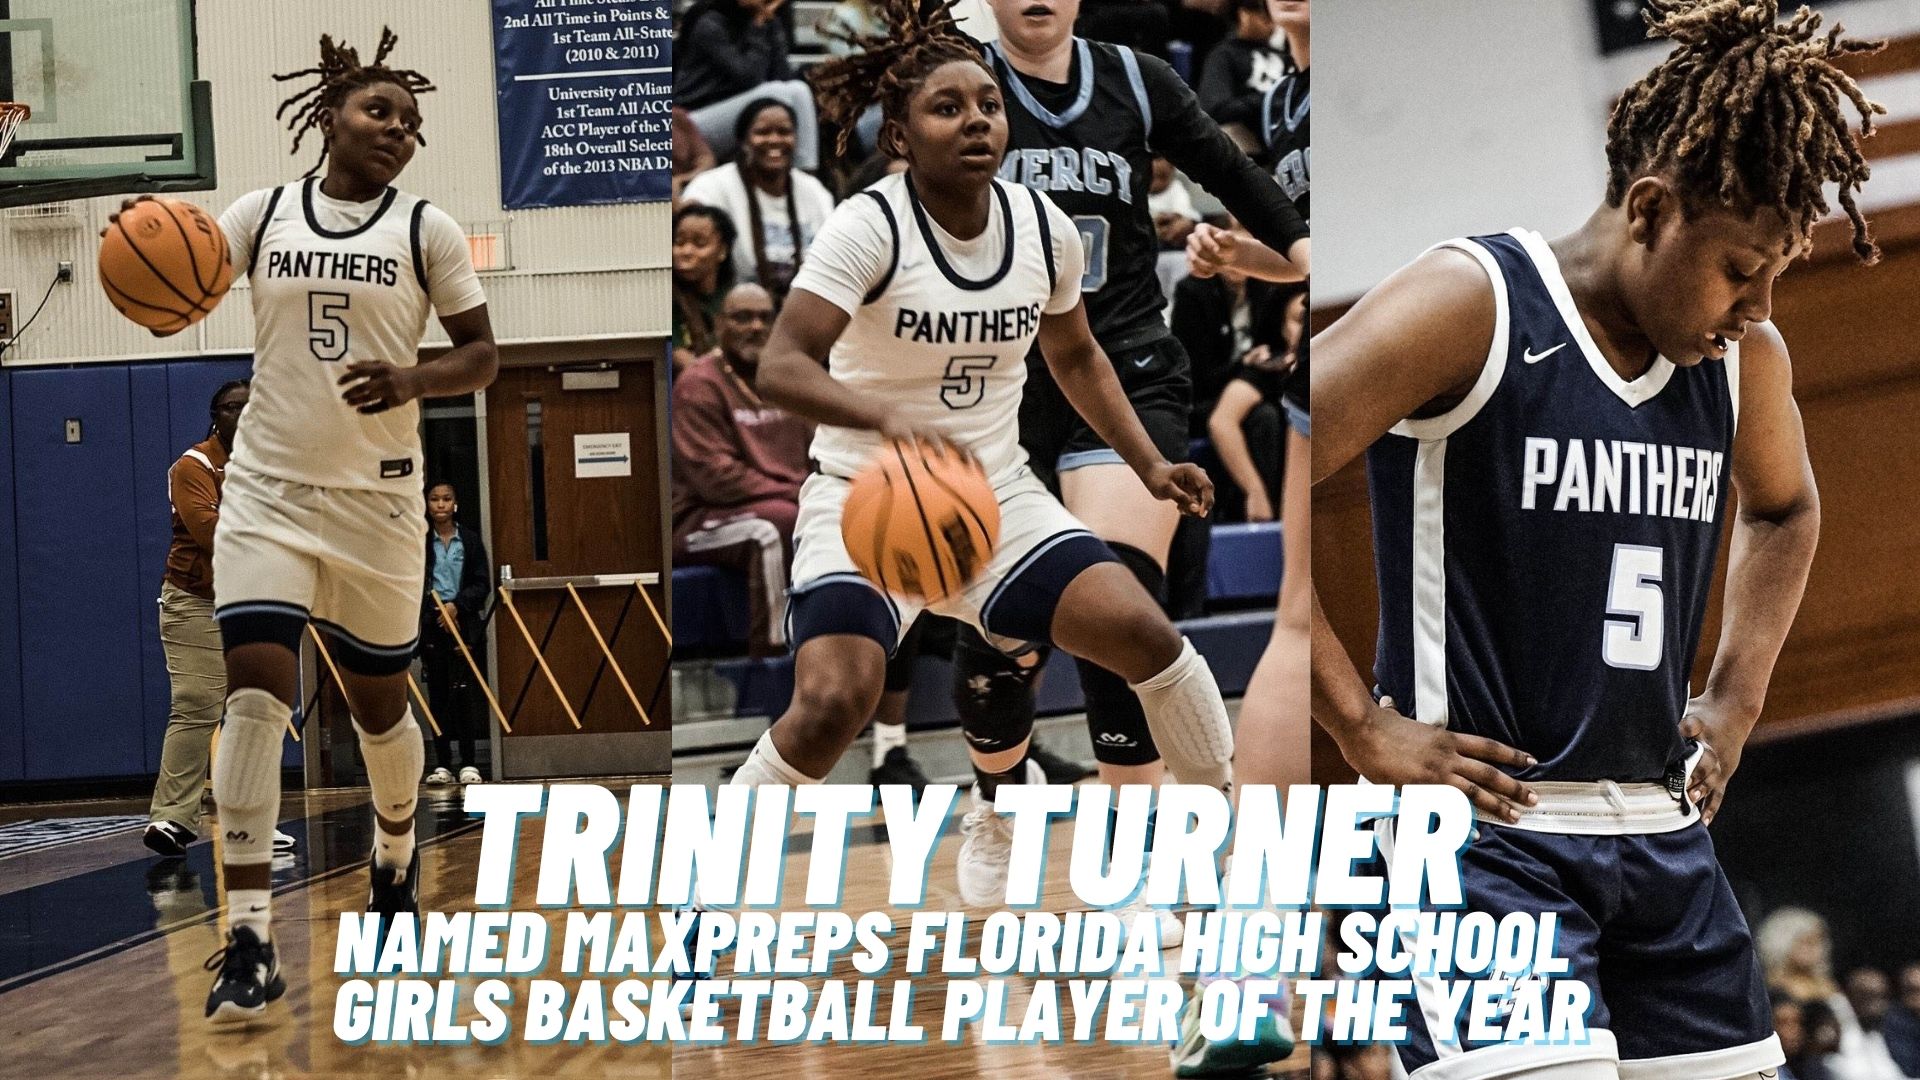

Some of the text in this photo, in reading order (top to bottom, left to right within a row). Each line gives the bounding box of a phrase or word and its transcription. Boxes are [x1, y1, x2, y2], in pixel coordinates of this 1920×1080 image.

[504, 6, 671, 29] 2nd All Time in Points &
[552, 26, 672, 45] 1st Team All-State
[565, 44, 660, 65] (2010 & 2011)
[548, 86, 617, 102] University
[619, 83, 634, 97] of
[556, 99, 672, 119] 1st Team All ACC
[541, 118, 672, 139] ACC Player of the Y
[544, 143, 574, 158] 18th
[576, 140, 627, 155] Overall
[543, 162, 560, 176] of
[560, 160, 582, 175] the
[584, 159, 616, 174] 2013
[618, 157, 654, 172] NBA
[267, 250, 399, 287] PANTHERS
[308, 291, 350, 362] 5
[894, 301, 1040, 344] PANTHERS
[940, 355, 998, 410] 5
[1521, 436, 1724, 524] PANTHERS
[1601, 543, 1665, 672] 5
